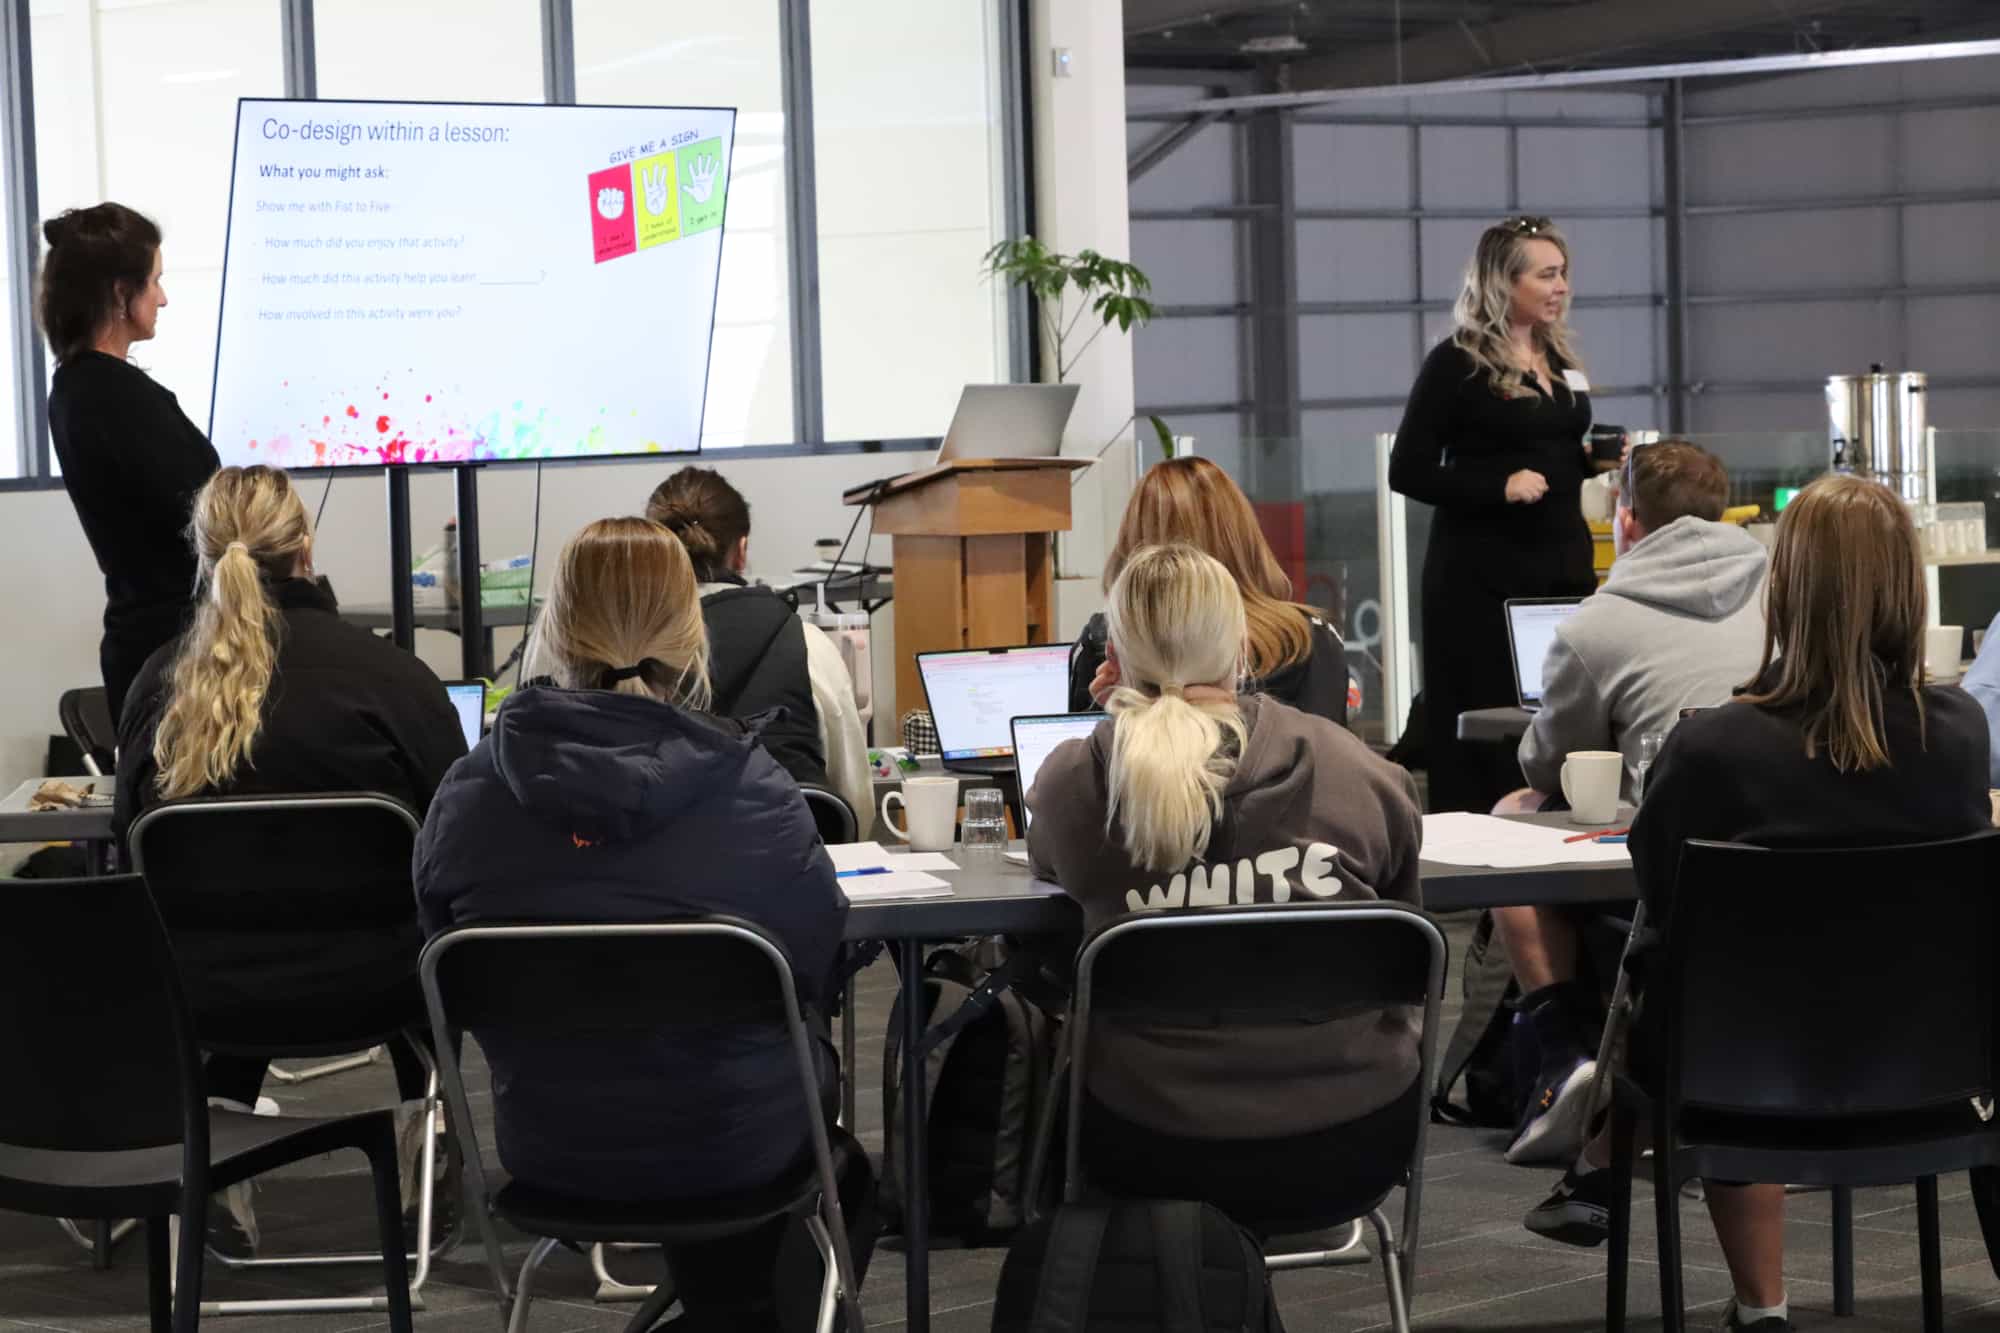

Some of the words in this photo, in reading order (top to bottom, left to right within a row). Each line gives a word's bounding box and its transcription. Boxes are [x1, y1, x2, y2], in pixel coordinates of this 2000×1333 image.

[262, 118, 361, 145] Co-design
[367, 120, 424, 141] within
[429, 126, 439, 141] a
[445, 121, 510, 142] lesson:
[608, 146, 636, 164] GIVE
[640, 140, 655, 153] ME
[659, 137, 667, 148] A
[671, 128, 699, 146] SIGN
[259, 164, 294, 177] What
[298, 167, 320, 181] you
[324, 163, 361, 181] might
[364, 164, 389, 178] ask:
[256, 199, 285, 212] Show
[288, 202, 305, 212] me
[308, 199, 332, 212] with
[356, 201, 367, 212] to
[265, 236, 289, 248] How
[292, 236, 323, 248] much
[325, 235, 343, 248] did
[345, 239, 365, 251] you
[367, 236, 396, 251] enjoy
[399, 235, 420, 248] that
[262, 271, 287, 284] How
[290, 271, 320, 284] much
[322, 271, 339, 284] did
[364, 271, 400, 286] activity
[403, 271, 427, 286] help
[429, 274, 448, 286] you
[258, 306, 283, 320] How
[286, 306, 331, 320] involved
[334, 307, 345, 319] in
[347, 305, 365, 319] this
[367, 305, 404, 321] activity
[408, 309, 433, 319] were
[436, 305, 462, 320] you?
[1126, 842, 1342, 911] WHITE
